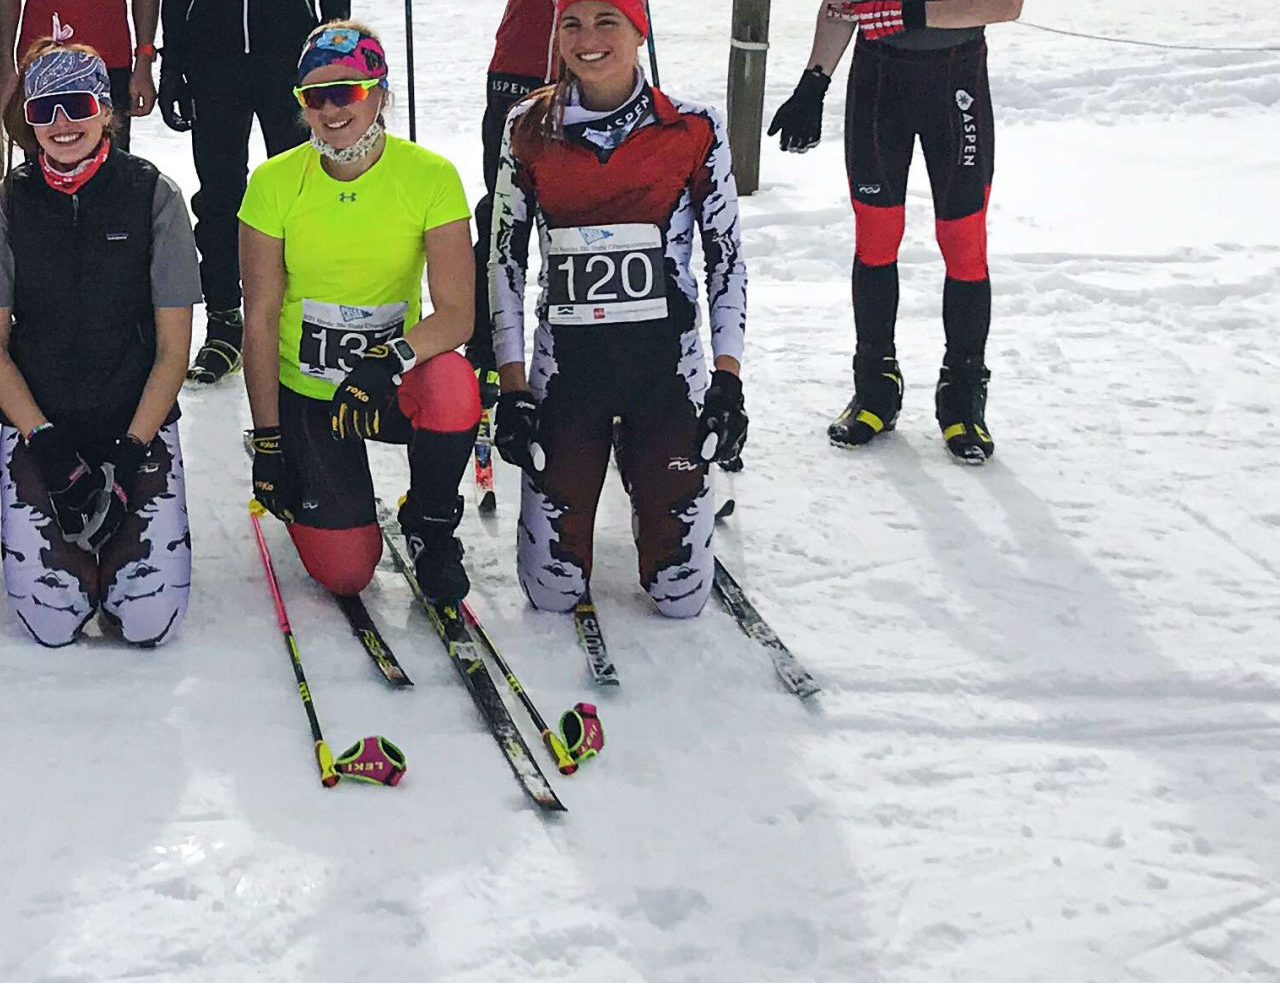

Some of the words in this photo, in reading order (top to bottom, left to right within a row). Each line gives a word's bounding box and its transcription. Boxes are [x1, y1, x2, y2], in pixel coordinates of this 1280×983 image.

[962, 113, 976, 166] ASPEN
[558, 252, 653, 301] 120
[347, 761, 383, 772] LEKI
